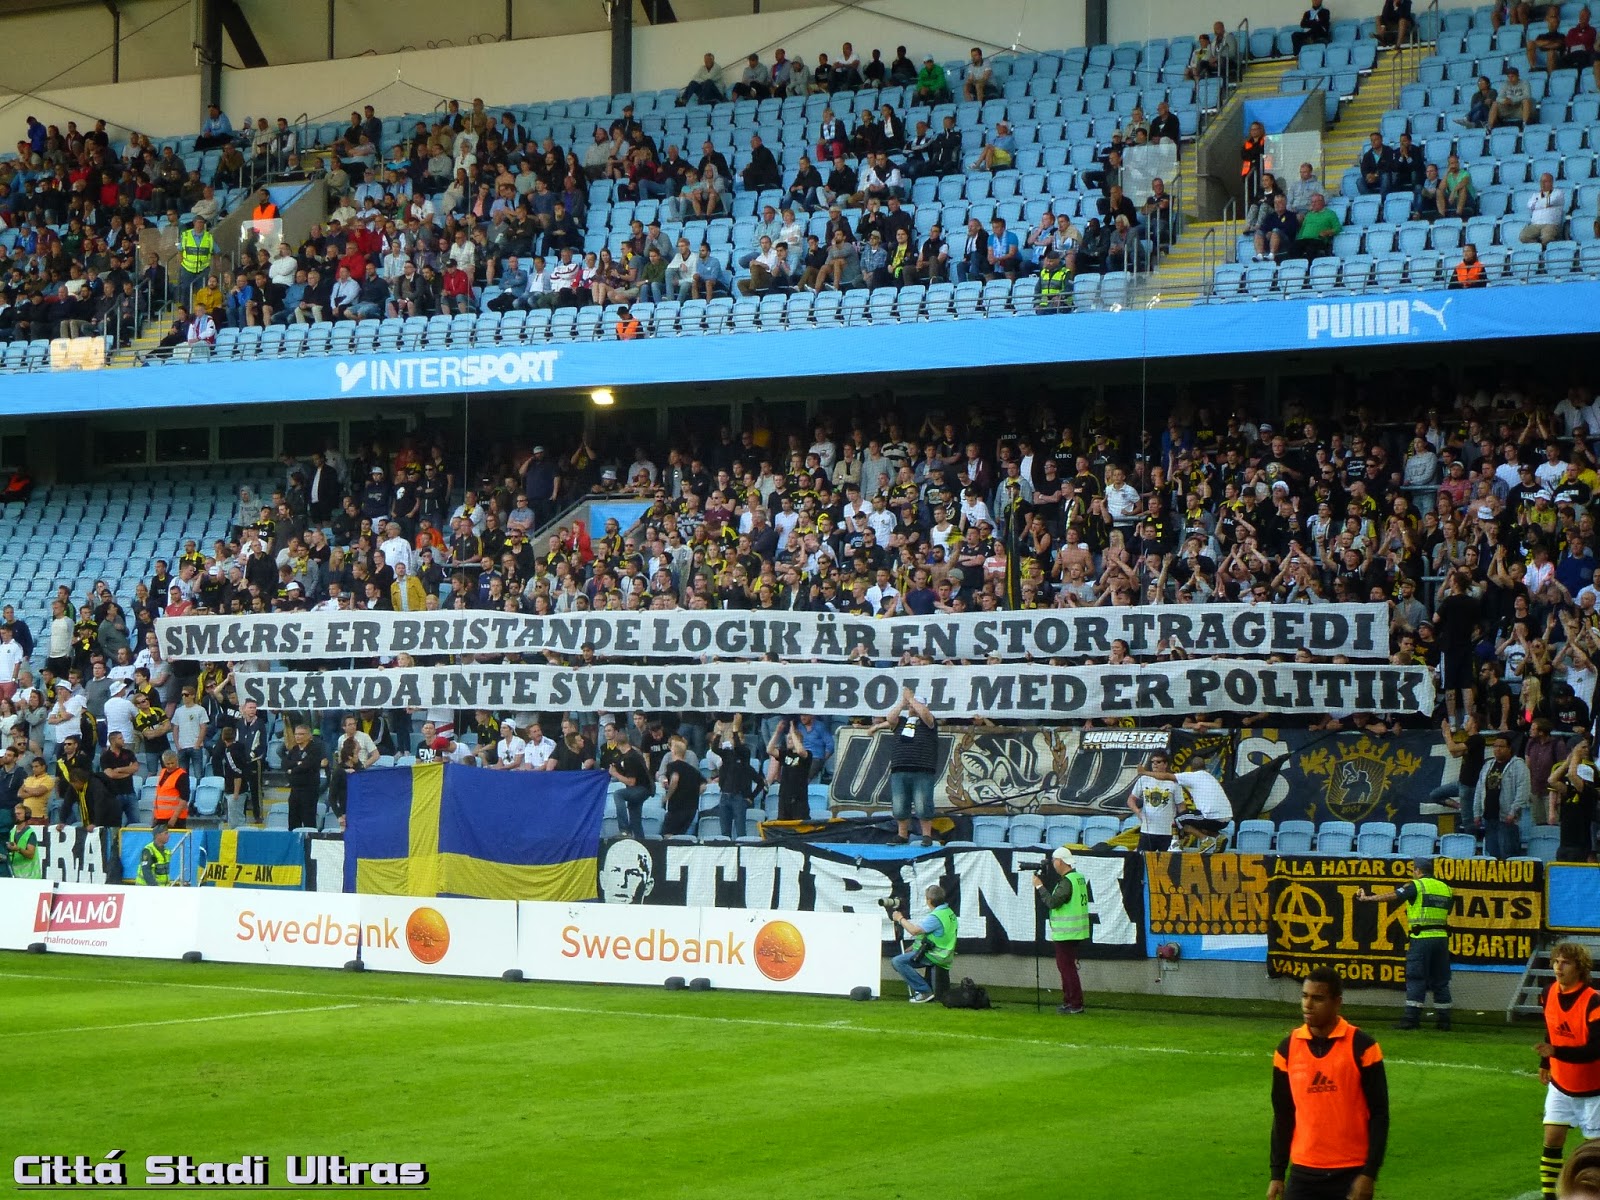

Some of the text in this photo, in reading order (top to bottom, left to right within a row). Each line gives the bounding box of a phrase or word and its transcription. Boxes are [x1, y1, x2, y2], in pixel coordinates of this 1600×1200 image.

[1308, 299, 1410, 340] PUMA
[370, 350, 559, 391] INTERSPORT
[166, 611, 1375, 657] SM&RS: ER BRISTANDE LOGIK ÄR EN STOR TRAGEDI
[244, 668, 1423, 712] SKÄNDA INTE SVENSK FOTBOLL MED ER POLITIK
[1083, 731, 1169, 743] YOUNGSTERS
[203, 863, 230, 881] ARE
[234, 865, 243, 881] 7
[254, 865, 273, 883] AIK
[1145, 852, 1268, 894] KAOS
[1321, 859, 1385, 876] HATAR
[1433, 857, 1535, 883] KOMMANDO
[41, 895, 118, 924] MALMÖ
[666, 845, 1138, 944] TURINA
[1150, 886, 1269, 922] BÄNKEN
[236, 910, 400, 949] Swedbank
[1272, 882, 1411, 951] AIK
[43, 935, 108, 948] malmotown.com
[562, 925, 746, 965] Swedbank
[1449, 932, 1531, 959] UBARTH
[1334, 960, 1374, 981] GÖR
